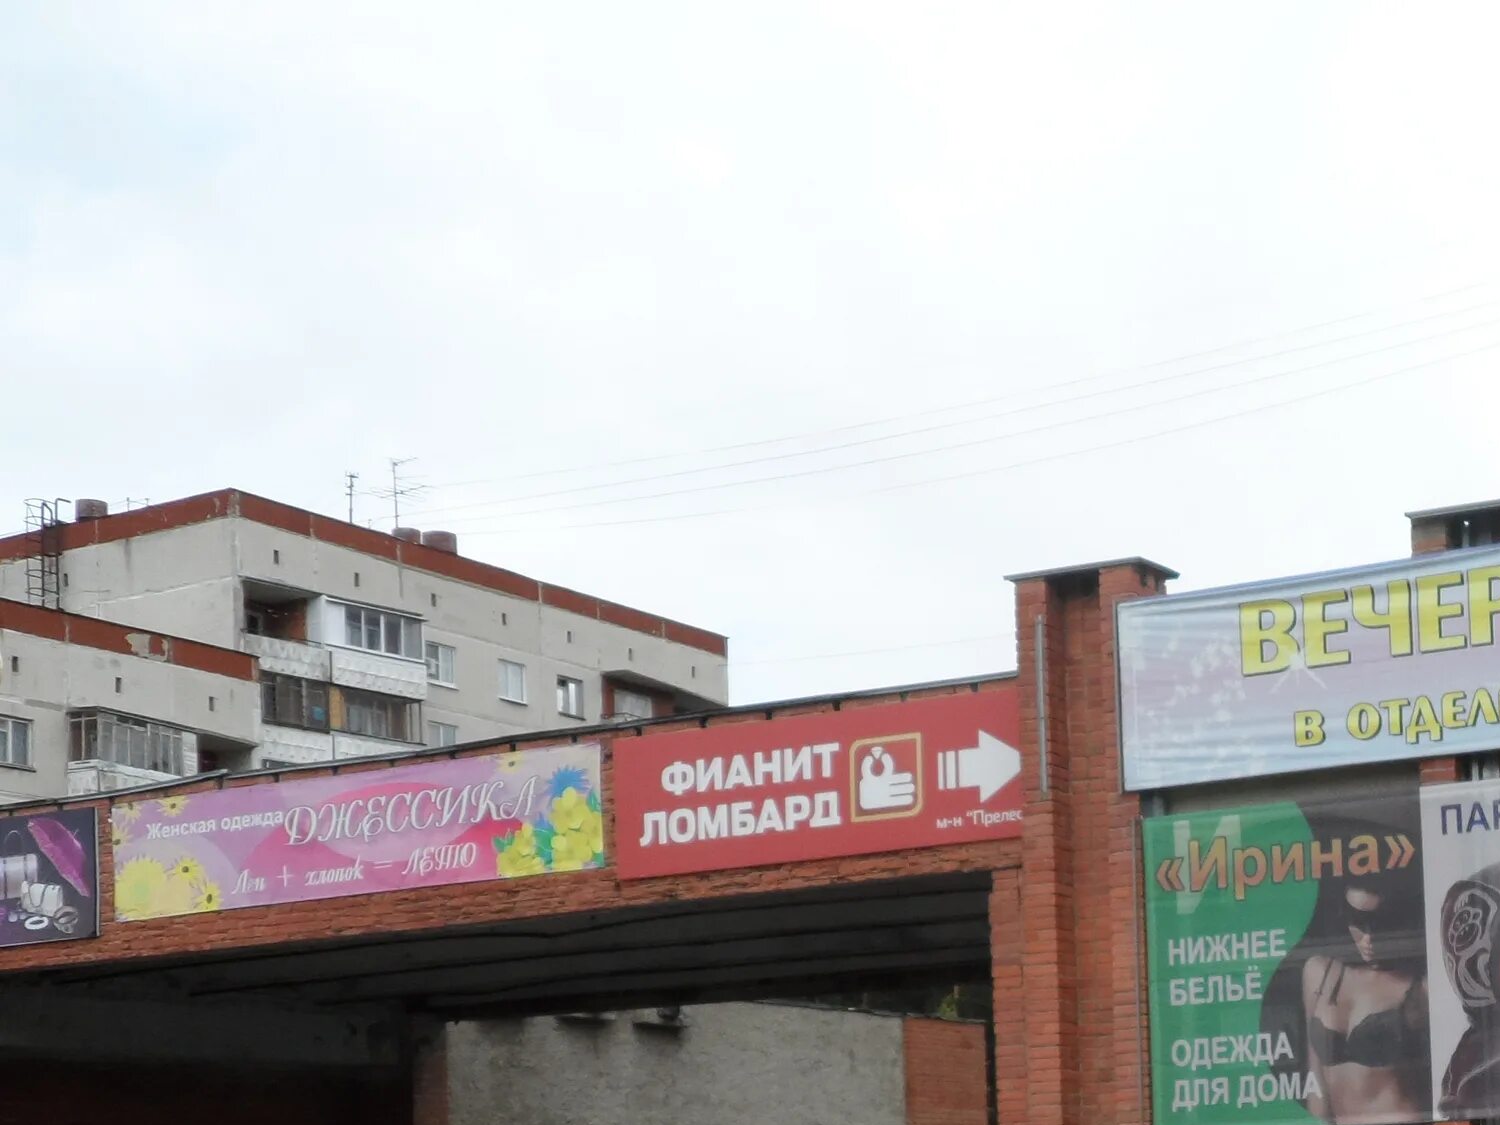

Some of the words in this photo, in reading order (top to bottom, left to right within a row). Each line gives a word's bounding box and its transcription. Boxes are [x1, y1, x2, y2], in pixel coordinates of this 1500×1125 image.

[661, 742, 840, 796] ФИАНИТ
[146, 819, 216, 839] Женская
[221, 811, 284, 832] одежда
[284, 776, 539, 845] ДЖЕССИКА
[640, 791, 842, 847] ЛОМБАРД
[936, 816, 962, 829] м-н
[305, 854, 364, 886] хлопок
[1156, 832, 1415, 901] «Ирина»
[1167, 928, 1287, 967] НИЖНЕЕ
[1169, 971, 1262, 1007] БЕЛЬЁ
[1171, 1031, 1294, 1072] ОДЕЖДА
[1171, 1079, 1233, 1113] ДЛЯ
[1236, 1070, 1323, 1105] ДОМА
